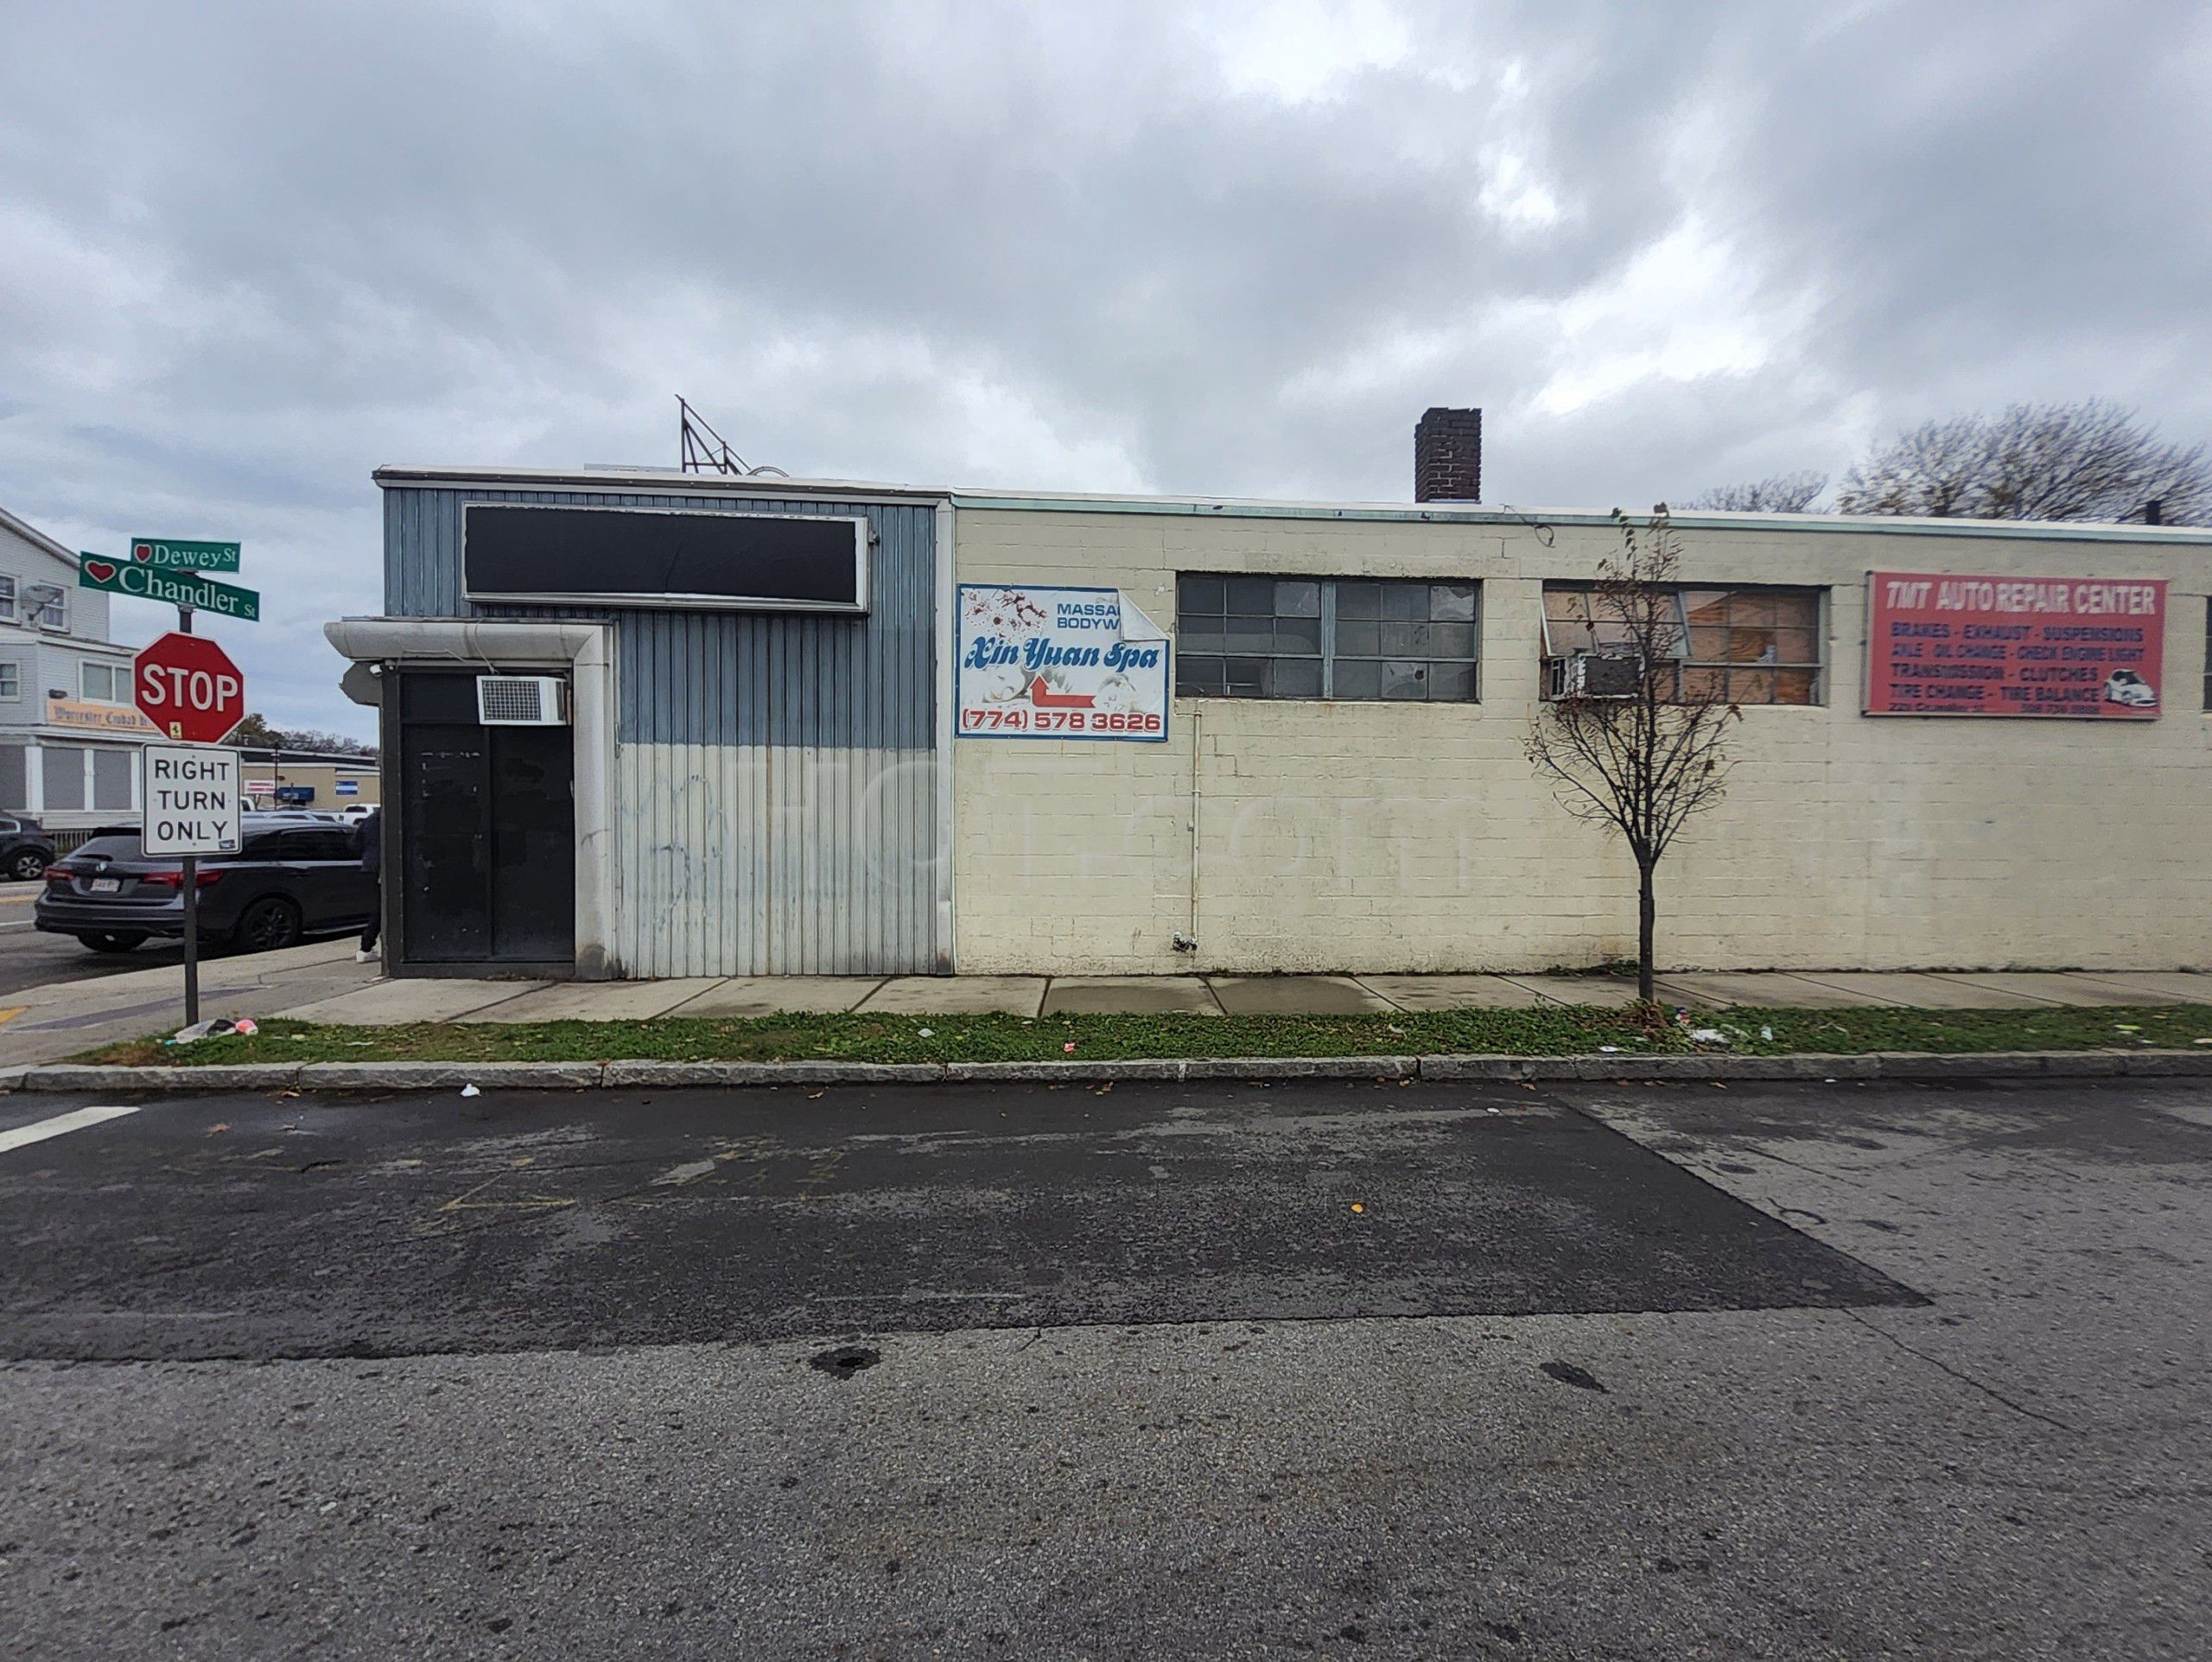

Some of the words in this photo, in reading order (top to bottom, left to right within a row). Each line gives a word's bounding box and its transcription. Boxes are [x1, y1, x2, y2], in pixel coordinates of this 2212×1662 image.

[154, 544, 221, 567] Dewey
[223, 548, 236, 562] St
[118, 566, 238, 613] Chandler
[245, 604, 255, 617] St
[1936, 582, 1993, 610] AUTO
[1996, 583, 2069, 613] REPAIR
[2075, 585, 2155, 614] CENTER
[964, 636, 1019, 670] Xin
[1023, 638, 1101, 671] Yuan
[1103, 642, 1160, 672] Spa
[141, 663, 238, 712] STOP
[963, 709, 1028, 730] (774)
[1034, 712, 1085, 729] 578
[1091, 713, 1160, 731] 3626
[155, 760, 230, 781] RIGHT
[157, 790, 226, 810] TURN
[157, 820, 228, 842] ONLY
